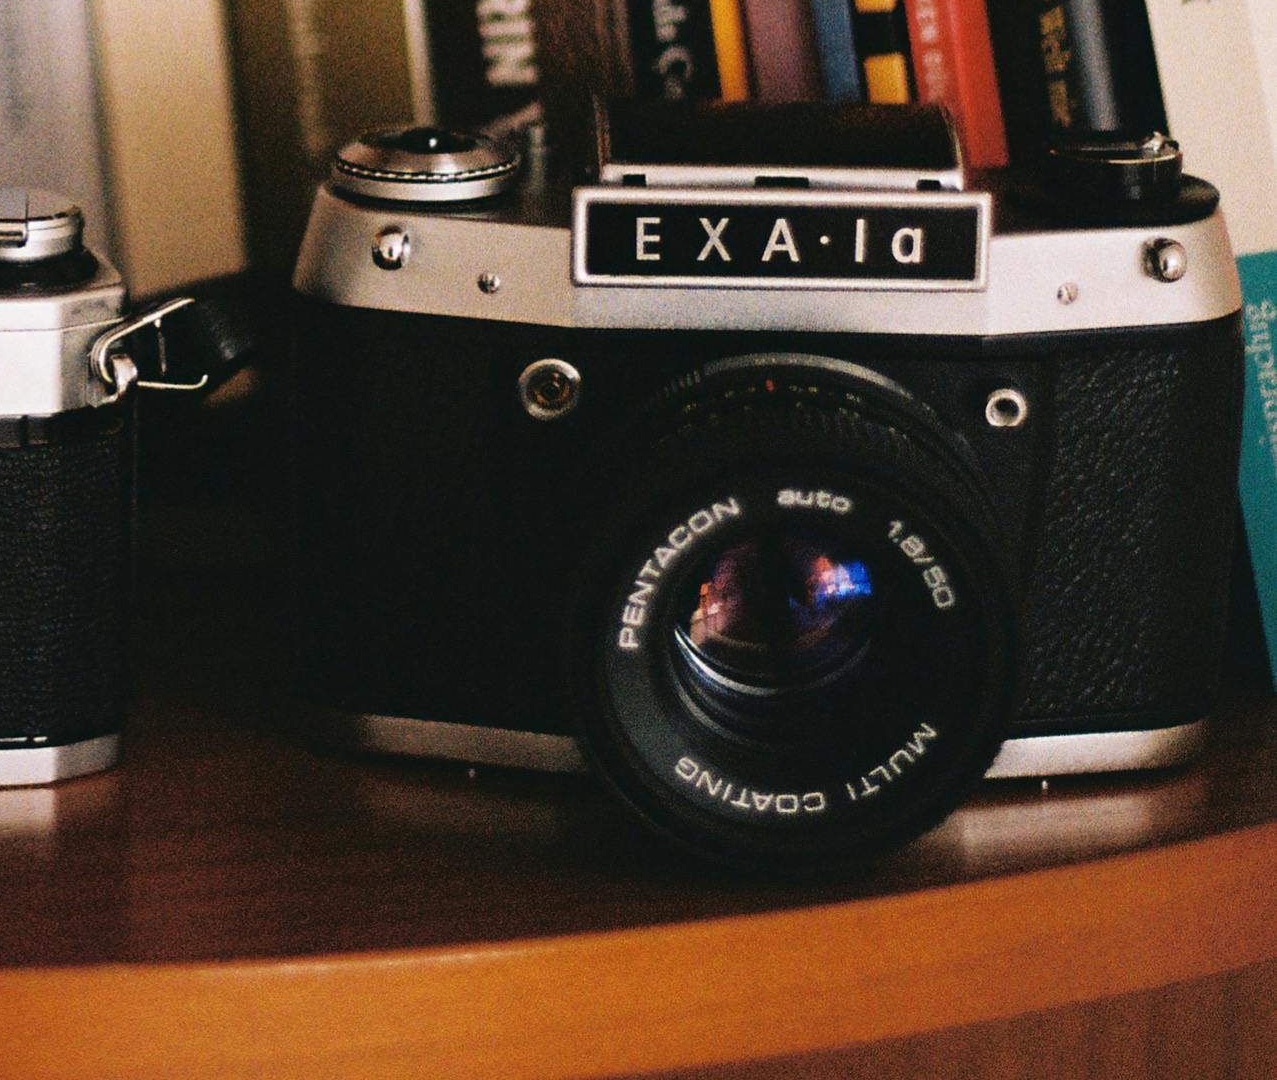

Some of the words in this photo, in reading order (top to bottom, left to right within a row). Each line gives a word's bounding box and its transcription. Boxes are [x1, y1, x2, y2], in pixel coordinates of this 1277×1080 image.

[618, 495, 742, 651] PENTACON
[777, 488, 855, 513] auto
[887, 518, 957, 610] 1.8/50
[673, 755, 828, 815] COATING
[844, 721, 939, 802] MULTI
